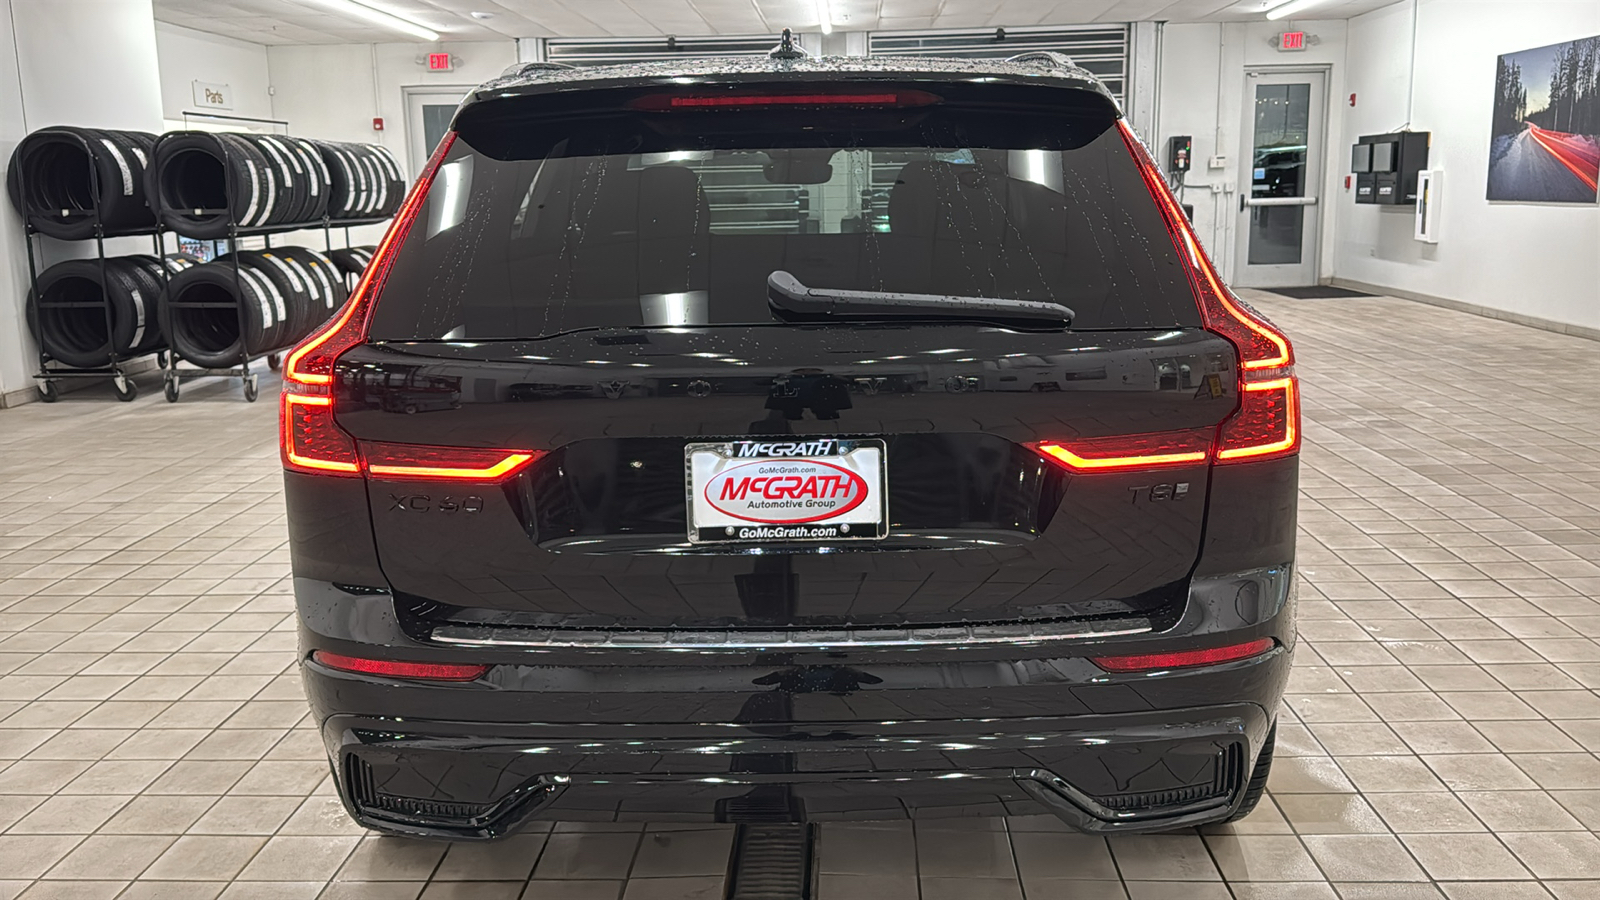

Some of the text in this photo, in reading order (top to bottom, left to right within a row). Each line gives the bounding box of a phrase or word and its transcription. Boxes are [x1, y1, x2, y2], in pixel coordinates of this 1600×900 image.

[1283, 32, 1303, 48] EXIT
[429, 53, 448, 69] EXIT
[758, 466, 817, 475] GoMcGrath.com
[747, 499, 836, 509] Automotive Group
[738, 526, 837, 539] GoMcGrath.com
